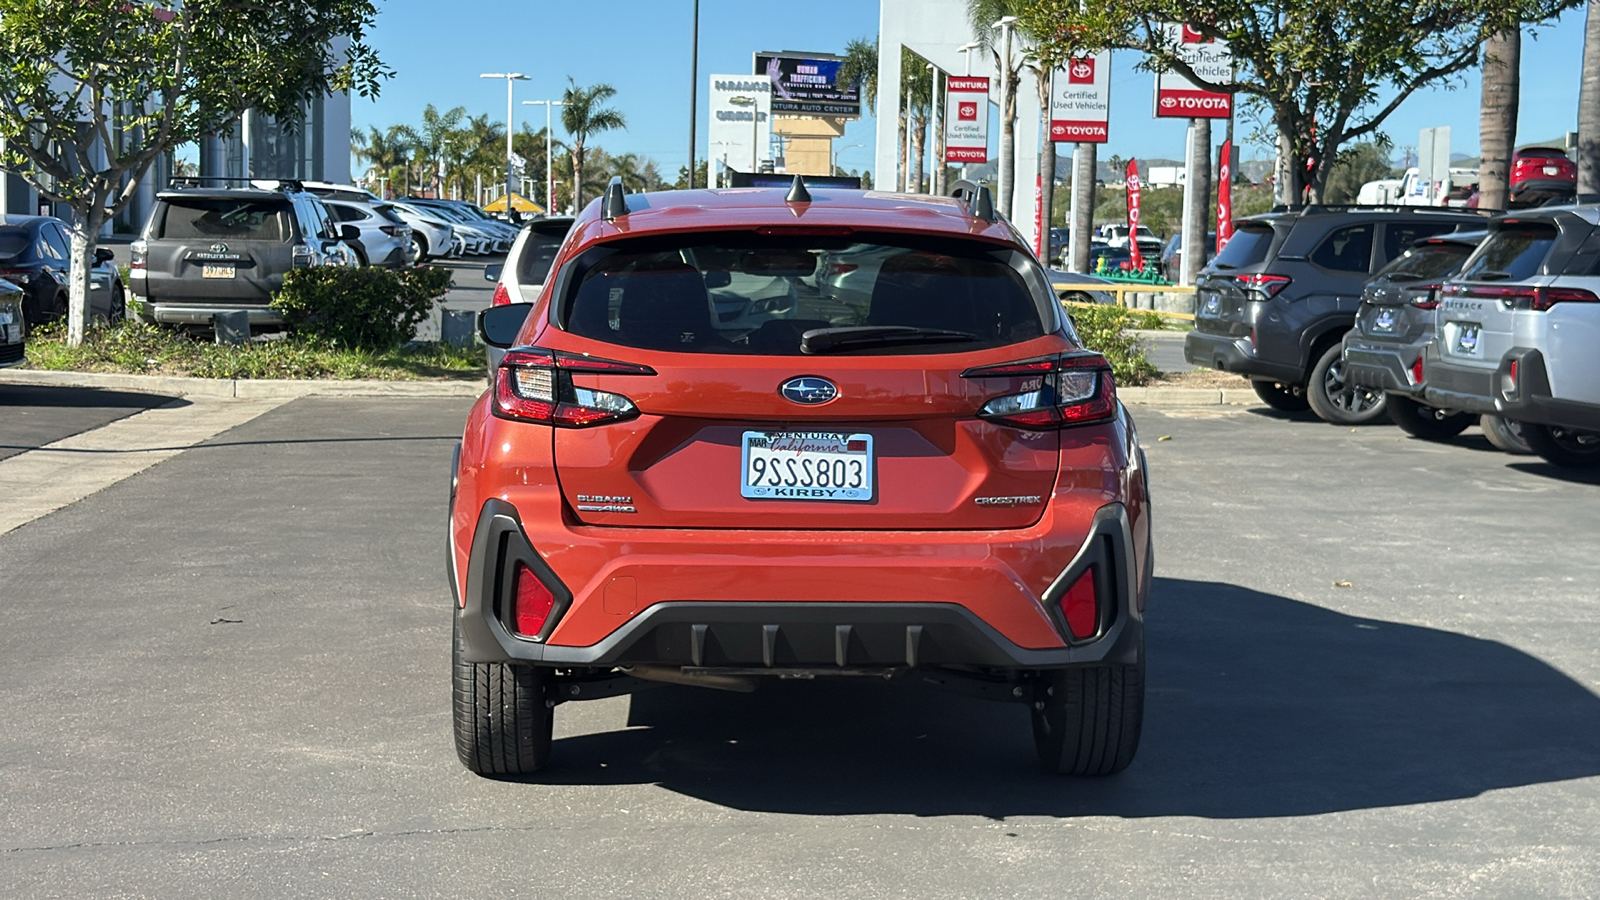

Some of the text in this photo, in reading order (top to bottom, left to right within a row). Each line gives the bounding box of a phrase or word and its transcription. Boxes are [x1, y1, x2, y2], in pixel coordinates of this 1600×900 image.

[1180, 51, 1220, 63] ertified
[949, 81, 988, 89] VENTURA
[1063, 91, 1098, 100] Certified
[1053, 101, 1107, 110] Used Vehicles
[1178, 97, 1229, 109] TOYOTA
[824, 105, 854, 113] CENTER
[1066, 126, 1106, 136] TOYOTA
[963, 132, 985, 140] Vehicles
[1445, 301, 1483, 310] OUTBACK
[776, 432, 839, 440] VENTURA
[750, 438, 767, 448] MAR
[769, 438, 842, 457] California
[752, 457, 862, 488] 9SSS803
[775, 488, 838, 497] KIRBY
[577, 494, 633, 503] SUBARU
[974, 496, 1041, 504] CROSSTREK
